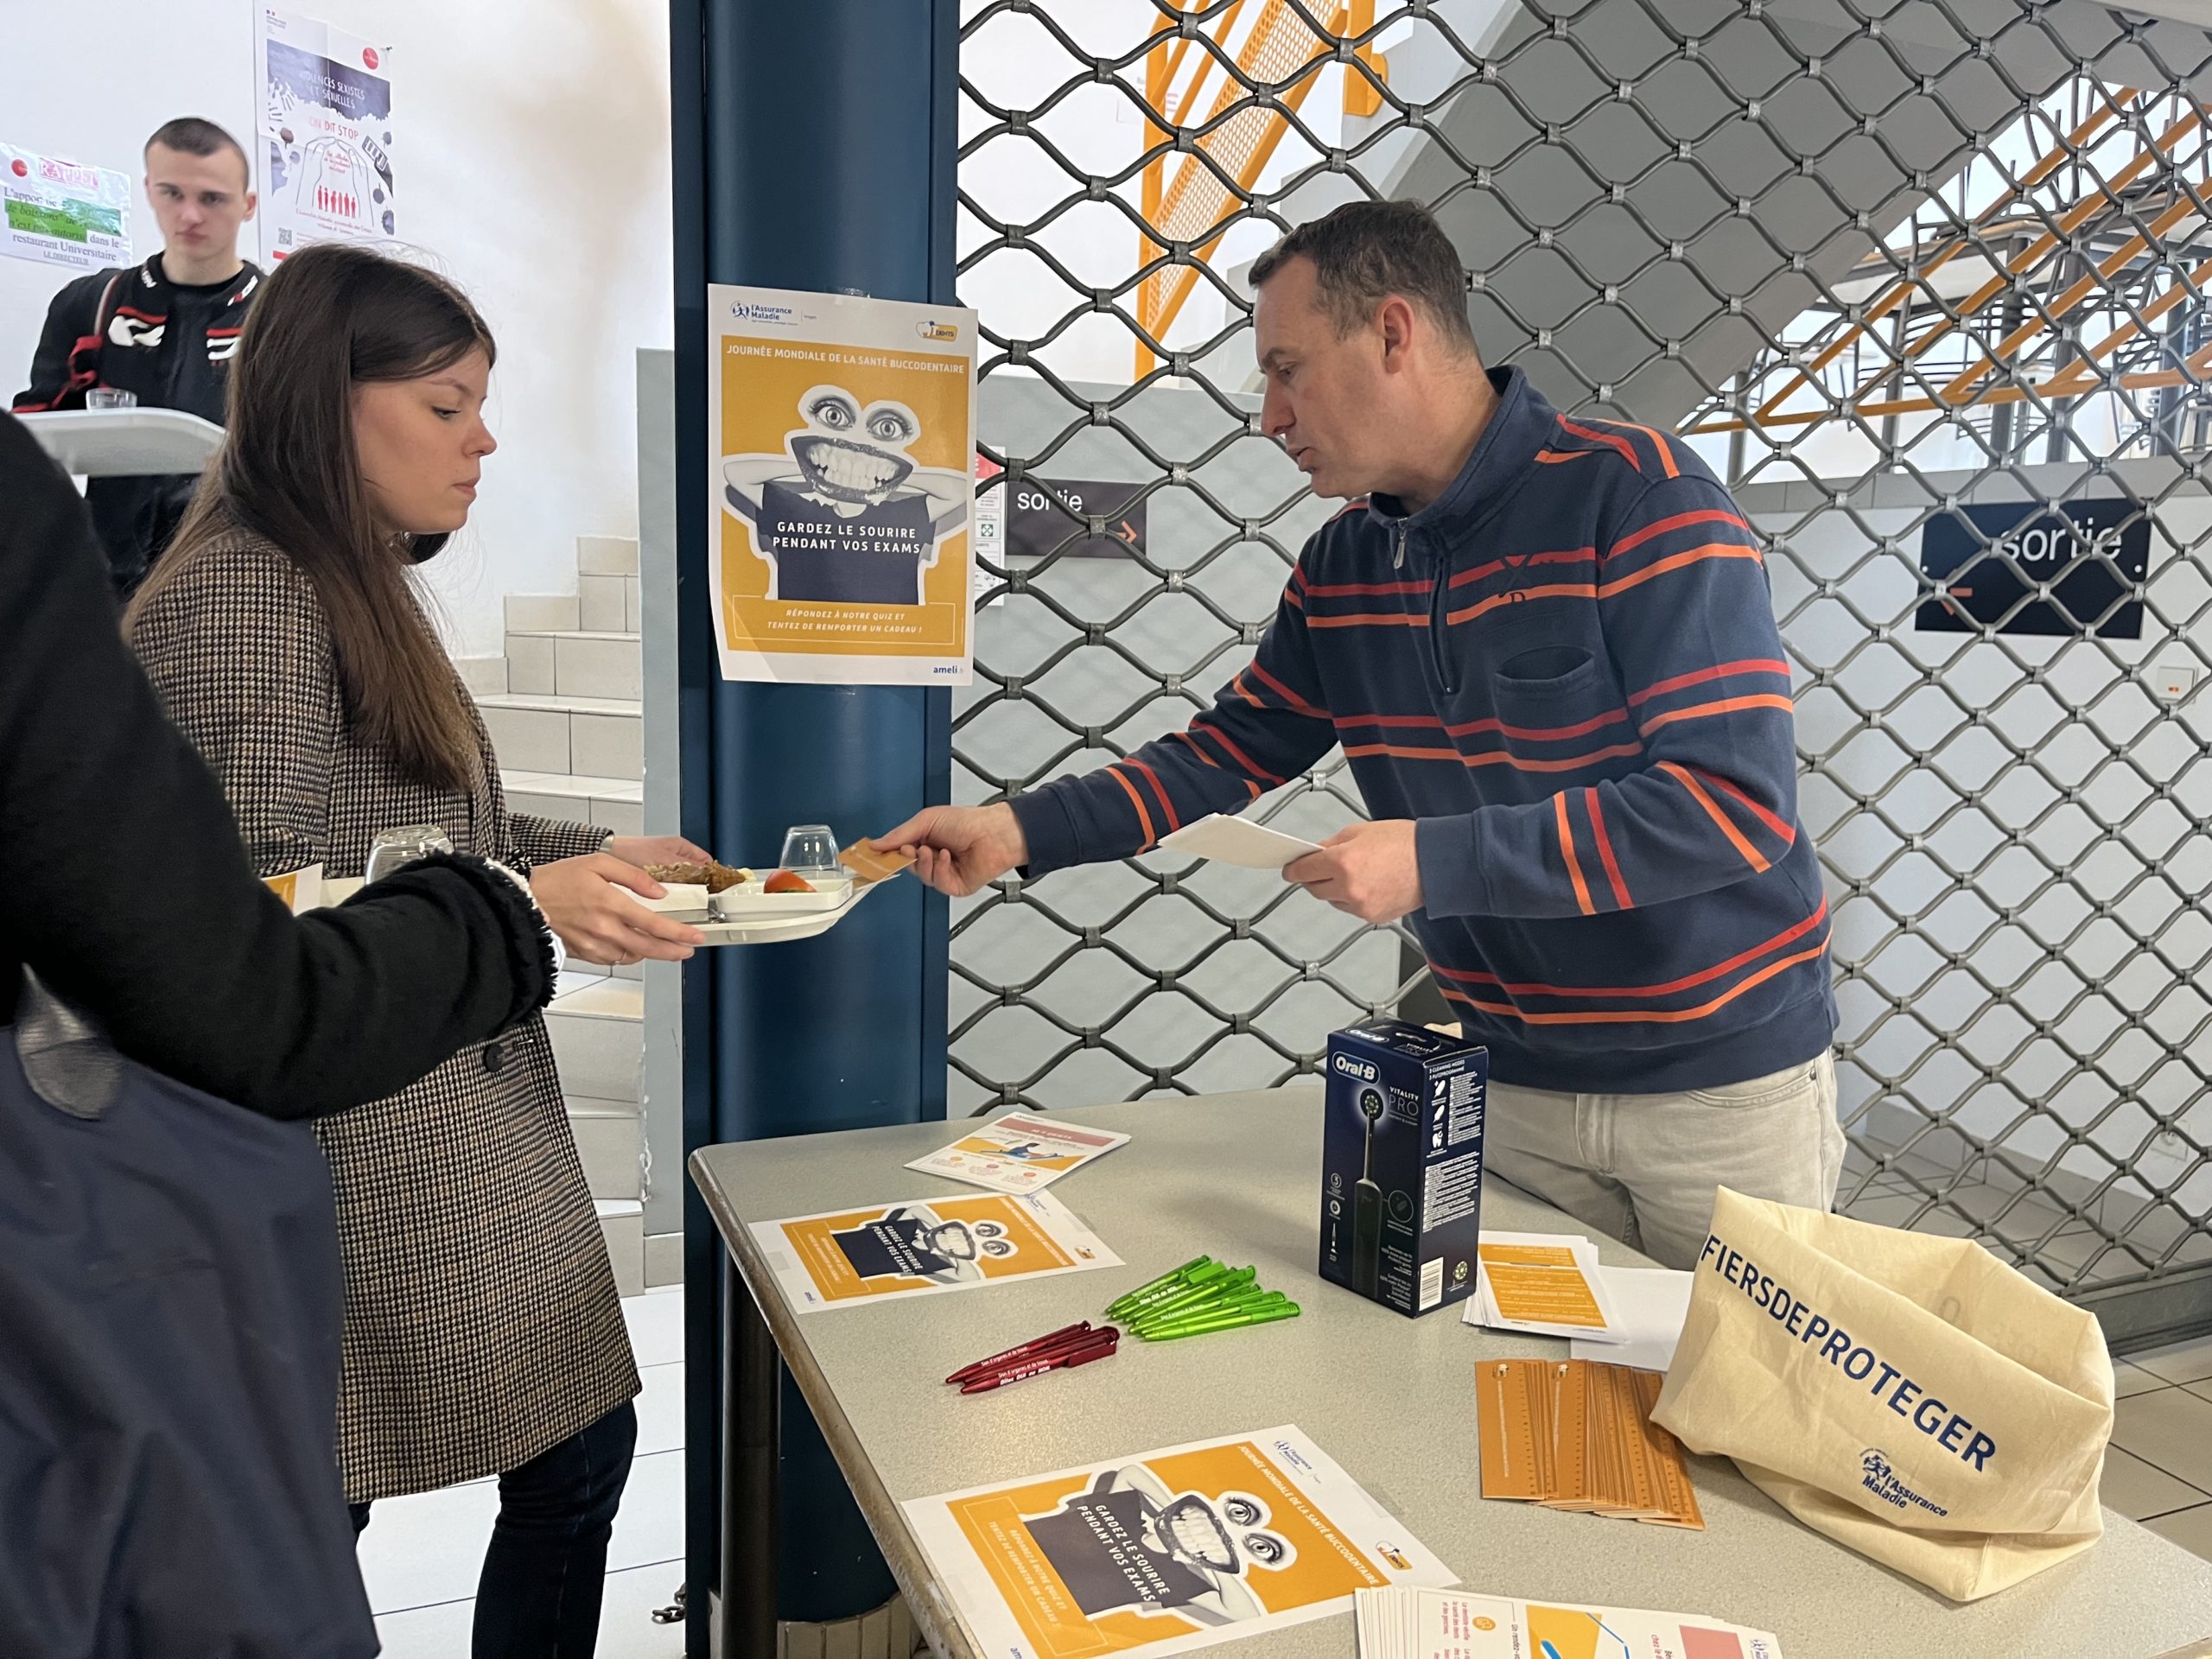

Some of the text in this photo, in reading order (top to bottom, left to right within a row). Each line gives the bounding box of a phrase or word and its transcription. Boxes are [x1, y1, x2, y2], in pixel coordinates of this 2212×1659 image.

[299, 71, 365, 100] OLENCES SEXISTES
[325, 121, 335, 132] DIT
[339, 125, 359, 139] STOP
[39, 161, 98, 189] RAPPEL
[13, 234, 117, 261] restaurant Universitaire
[90, 234, 109, 246] dans
[111, 238, 119, 248] le
[751, 304, 792, 315] l'Assurance
[751, 312, 780, 321] Maladie
[727, 345, 965, 374] JOURNÉE MONDIALE DE LA SANTÉ BUCCODENTAIRE
[778, 521, 916, 539] GARDEZ LE SOURIRE
[1999, 517, 2123, 563] sortie
[772, 537, 920, 554] PENDANT VOS EXAMS
[786, 607, 832, 619] RÉPONDEZ
[834, 608, 840, 619] À
[872, 613, 893, 621] QUIZ
[767, 621, 800, 630] TENTEZ
[802, 622, 813, 631] DE
[816, 623, 868, 632] REMPORTER
[869, 624, 882, 632] UN
[884, 625, 917, 633] CADEAU
[933, 664, 958, 674] ameli
[1335, 1056, 1376, 1080] Oral-B
[1389, 1086, 1419, 1102] VITALITY
[1389, 1094, 1419, 1116] PRO
[1700, 1234, 1996, 1472] FIERSDEPROTEGER
[1862, 1475, 1907, 1509] Maladie
[1885, 1475, 1948, 1516] l'Assurance
[1237, 1445, 1380, 1585] JOURNÉE MONDIALE DE LA SANTÉ BUCCODENTAIRE
[1077, 1505, 1156, 1603] PENDANT VOS EXAMS
[1095, 1504, 1171, 1595] GARDEZ LE SOURIRE
